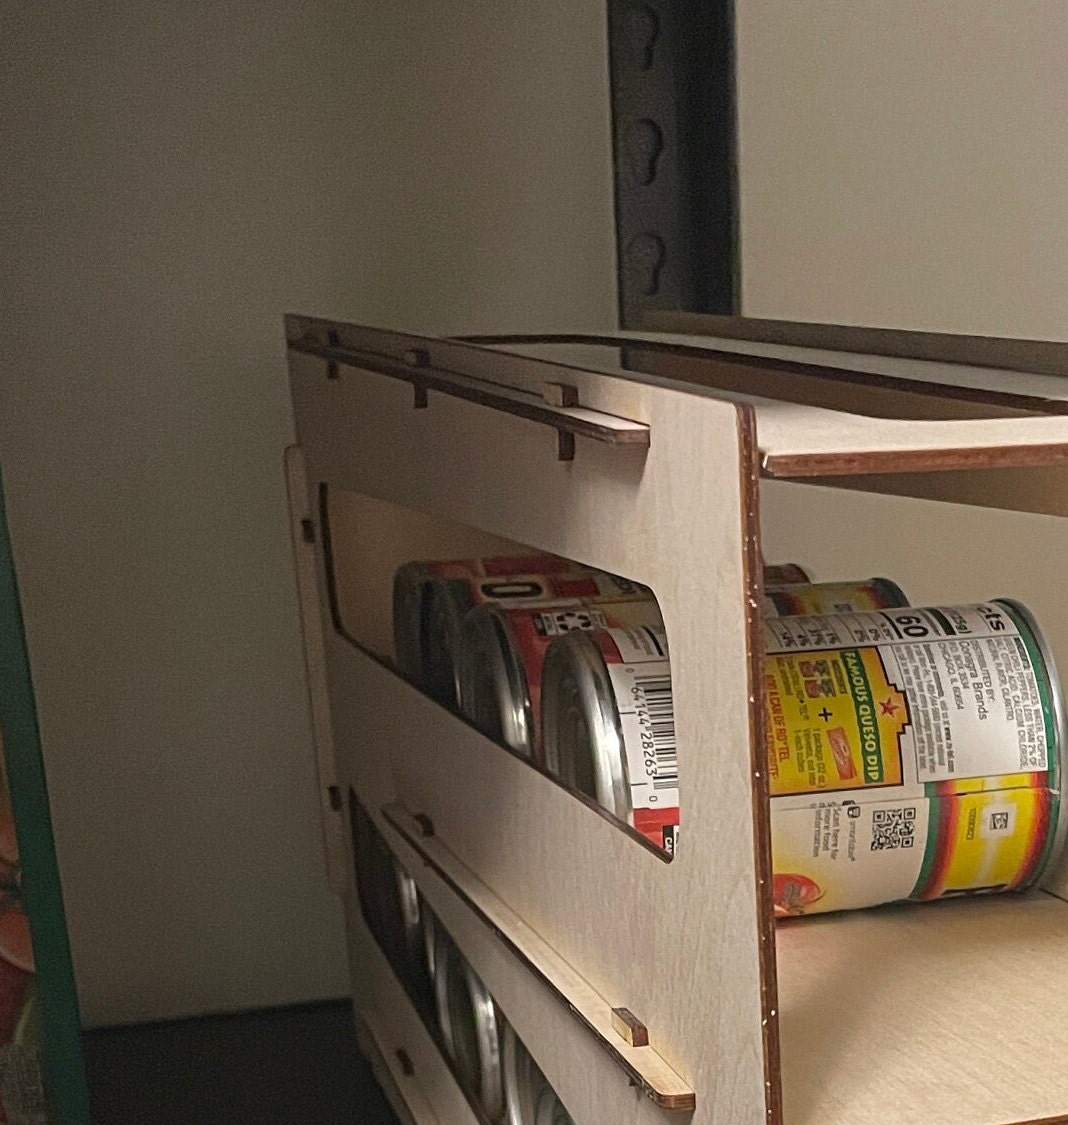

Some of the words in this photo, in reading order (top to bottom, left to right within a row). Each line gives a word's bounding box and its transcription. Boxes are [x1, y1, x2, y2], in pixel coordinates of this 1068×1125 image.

[896, 615, 929, 638] 60
[845, 652, 868, 702] FAMOUS
[959, 641, 979, 678] Conagra
[972, 682, 988, 720] Brands
[631, 686, 647, 726] 64144
[640, 731, 658, 777] 28263
[859, 705, 876, 752] QUESO
[867, 755, 878, 780] DIP
